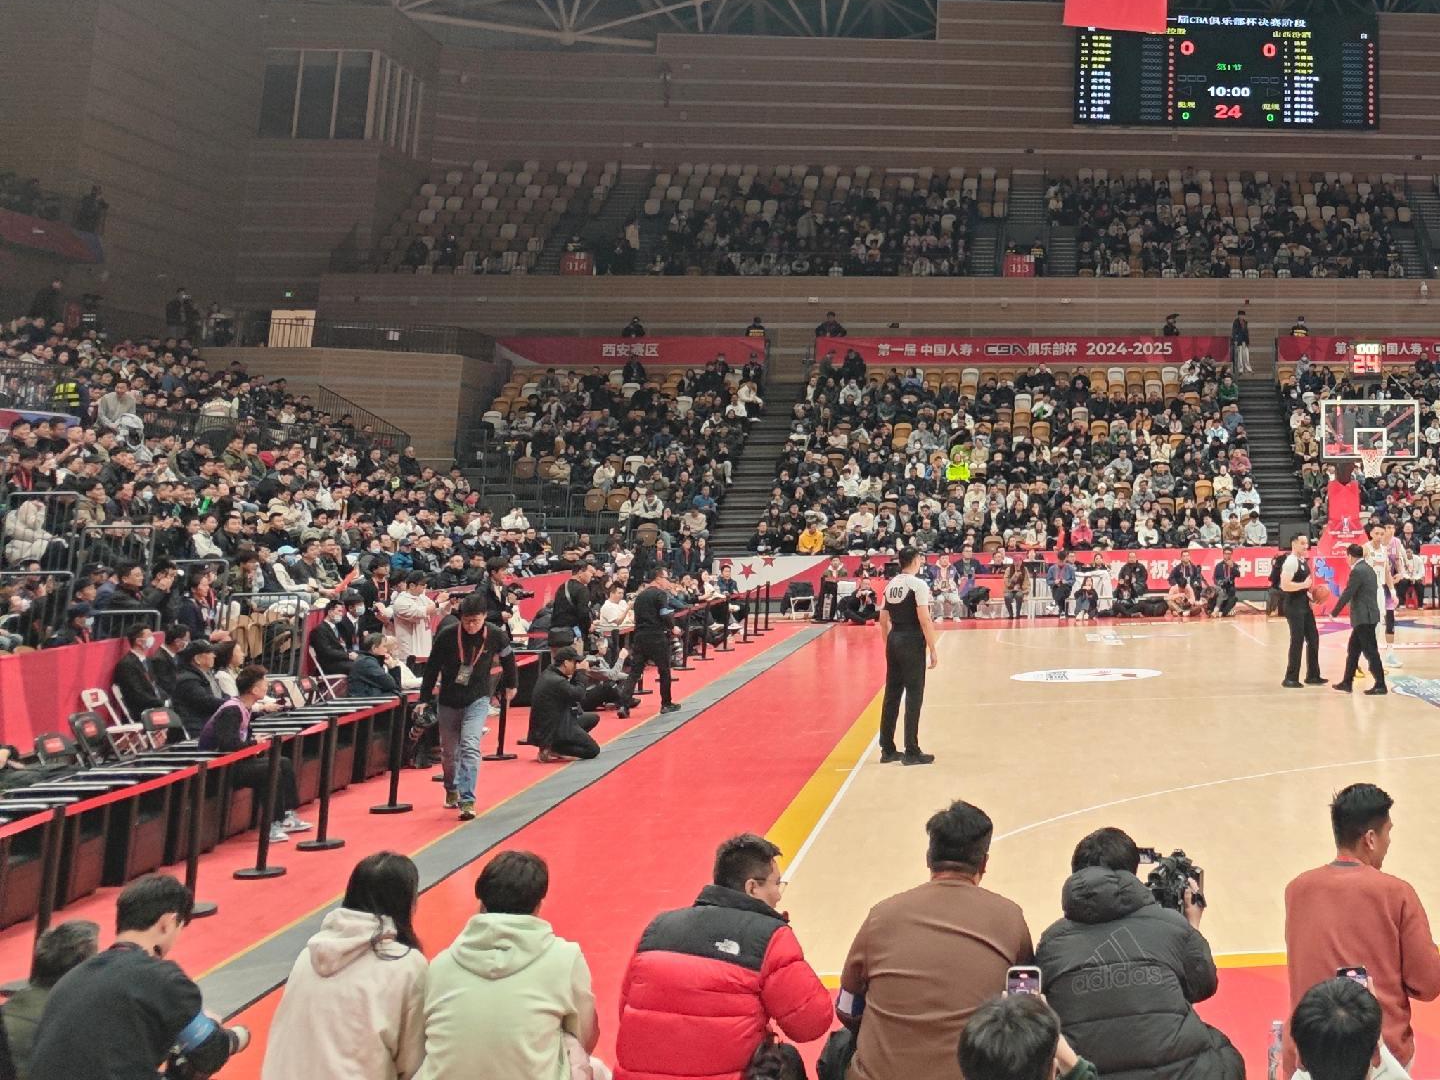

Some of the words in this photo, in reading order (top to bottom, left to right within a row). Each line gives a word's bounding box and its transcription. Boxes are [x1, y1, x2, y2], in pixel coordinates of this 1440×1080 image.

[1180, 40, 1194, 55] 0
[1263, 43, 1277, 57] 0
[1207, 85, 1251, 97] 10:00
[1214, 104, 1242, 119] 24
[602, 343, 659, 358] 西安赛区
[878, 343, 917, 357] 第一届
[1086, 342, 1172, 356] 2024-2025
[1354, 355, 1380, 374] 24
[889, 587, 904, 599] 106
[1071, 963, 1162, 995] adidas
